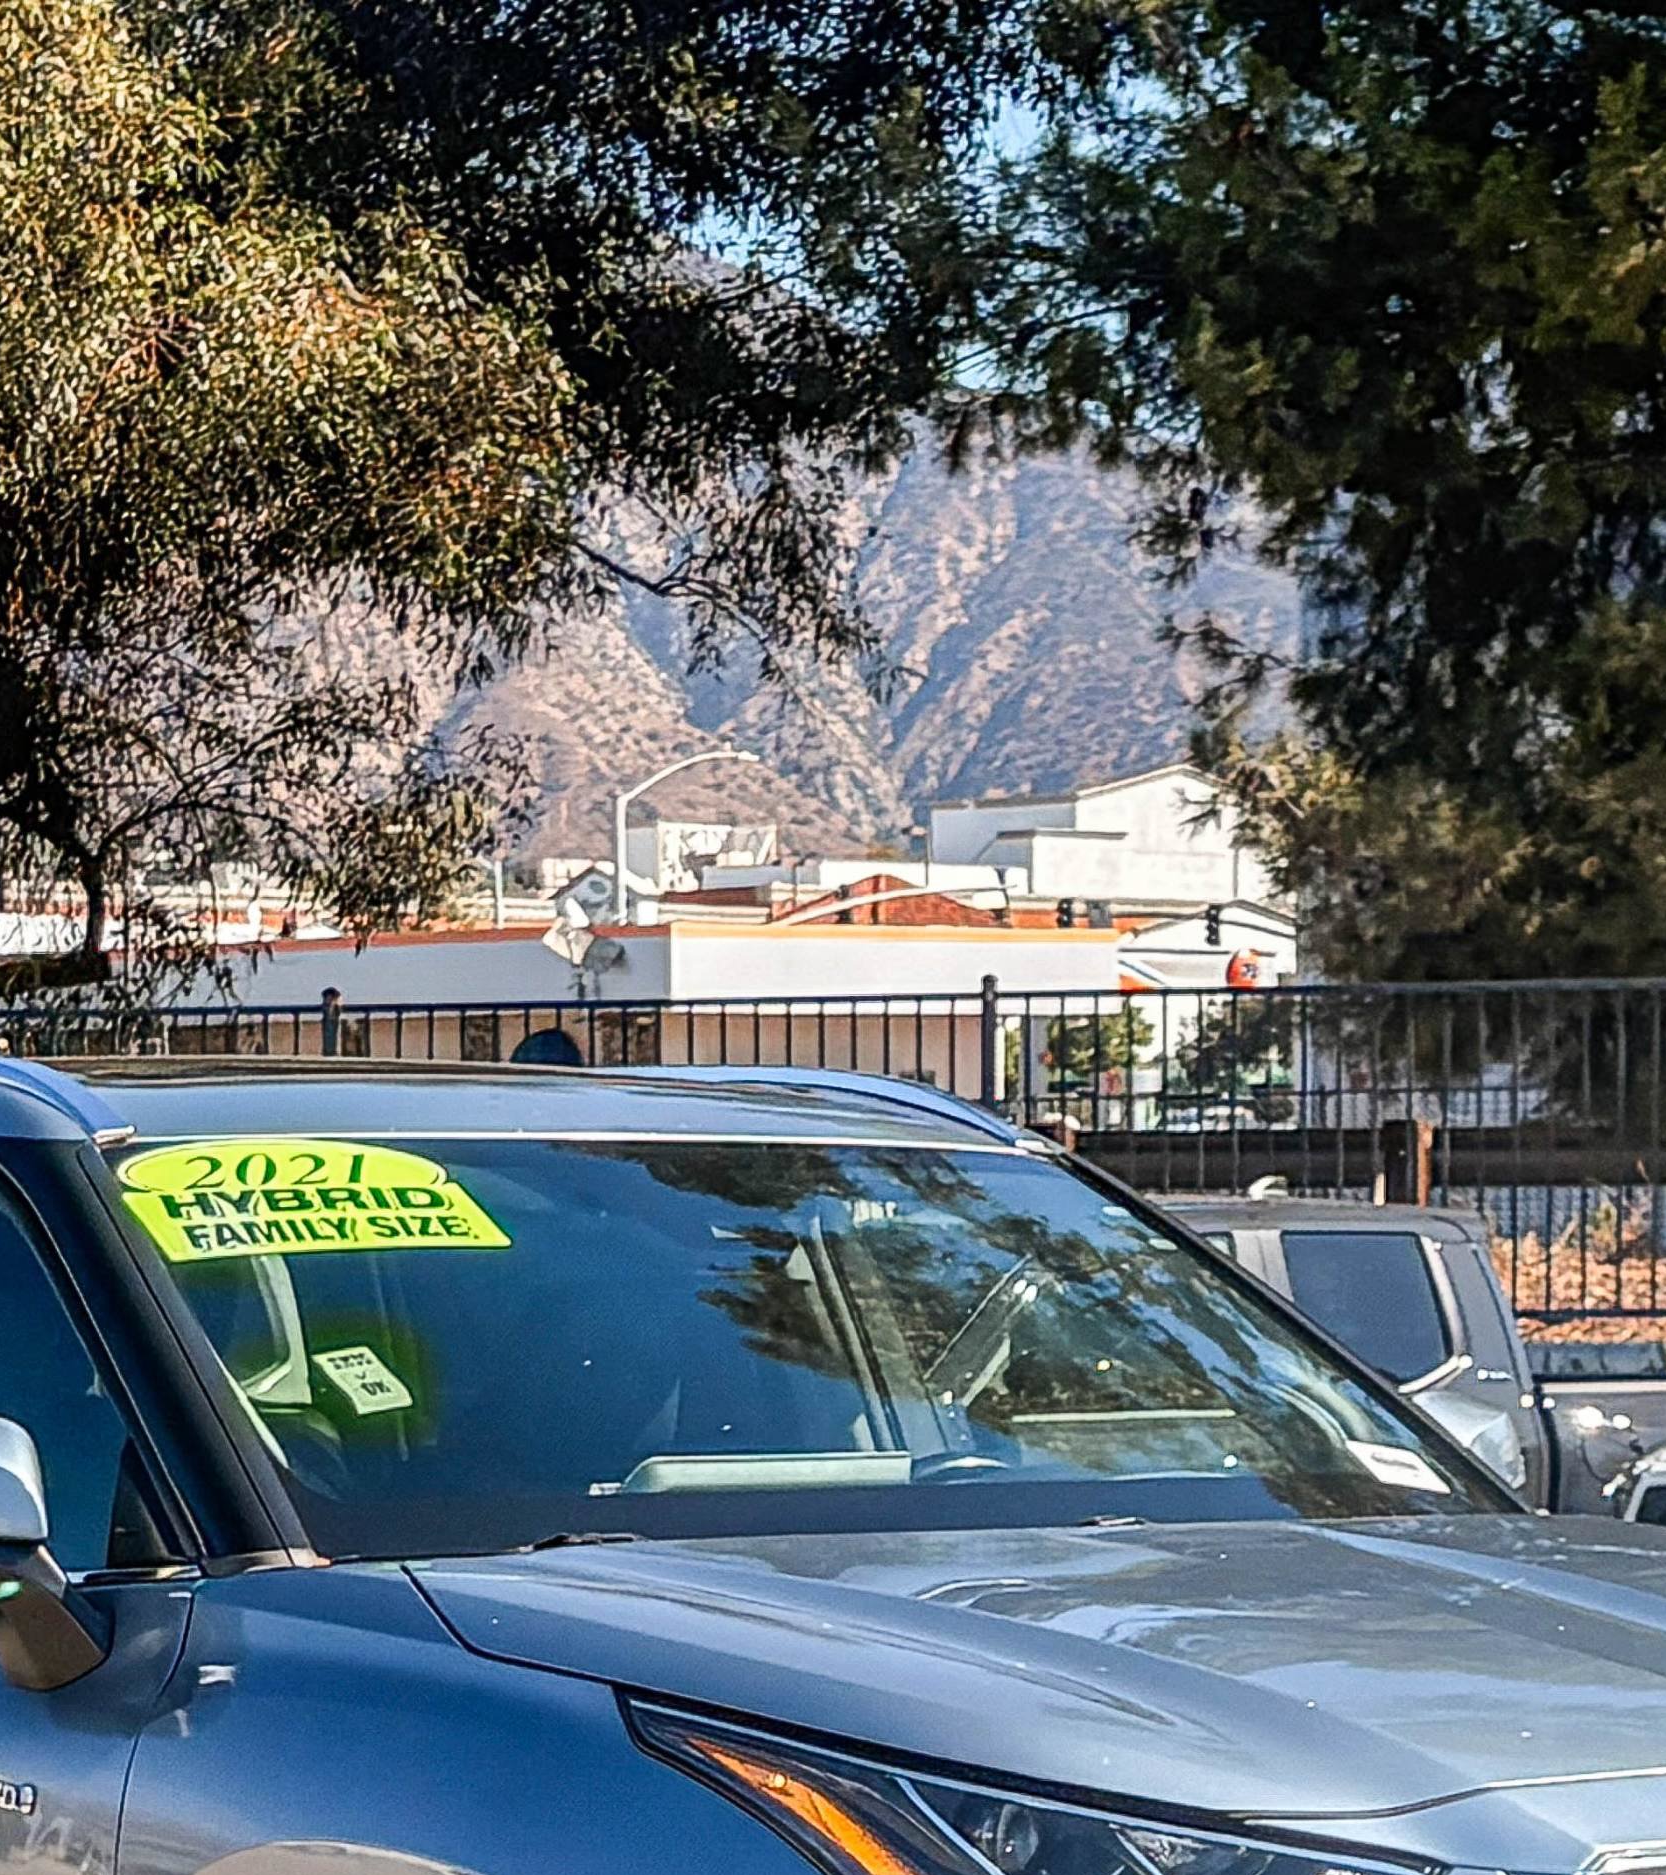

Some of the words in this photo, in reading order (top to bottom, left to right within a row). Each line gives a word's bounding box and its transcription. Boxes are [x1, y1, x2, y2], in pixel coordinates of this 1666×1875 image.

[184, 1152, 365, 1190] 2021
[159, 1186, 450, 1220] HYBRID
[182, 1215, 353, 1249] FAMILY
[365, 1215, 471, 1239] SIZE
